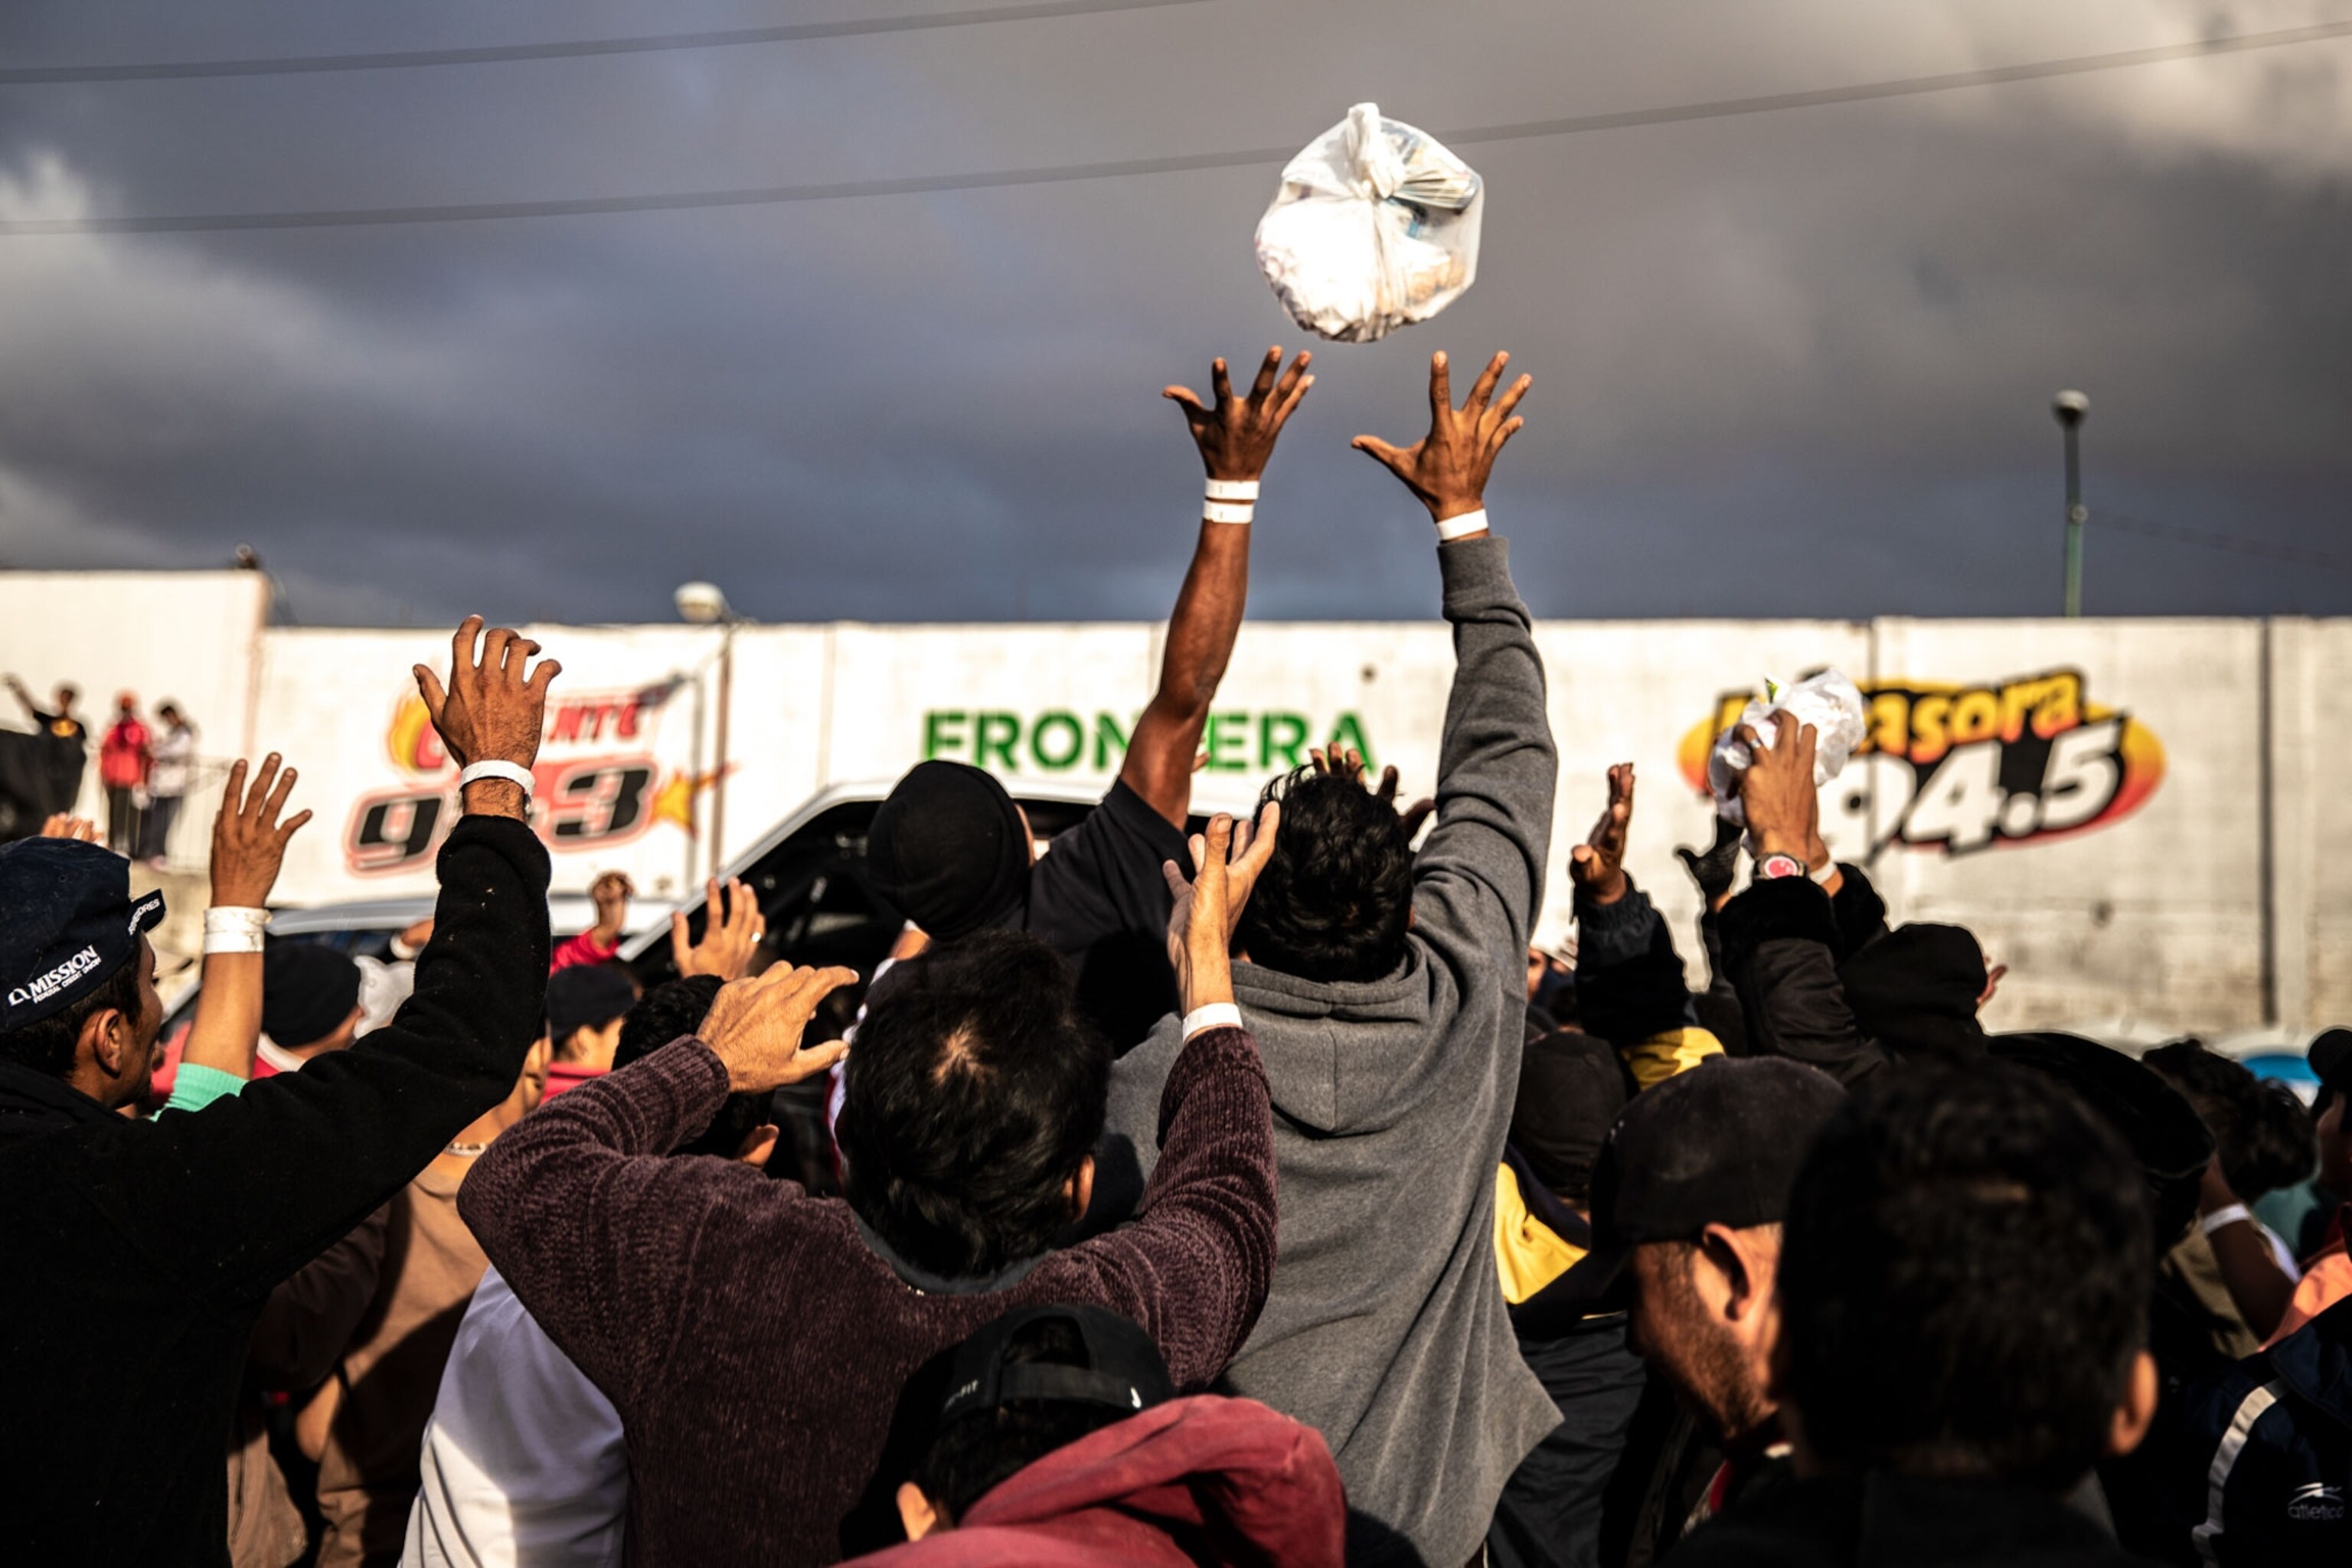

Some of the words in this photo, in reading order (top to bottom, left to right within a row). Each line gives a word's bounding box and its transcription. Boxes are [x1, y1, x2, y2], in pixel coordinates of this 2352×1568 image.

[925, 711, 1376, 770] FRONERA
[28, 944, 99, 996] MISSION
[61, 970, 83, 988] CREDIT
[83, 956, 102, 974] UNION
